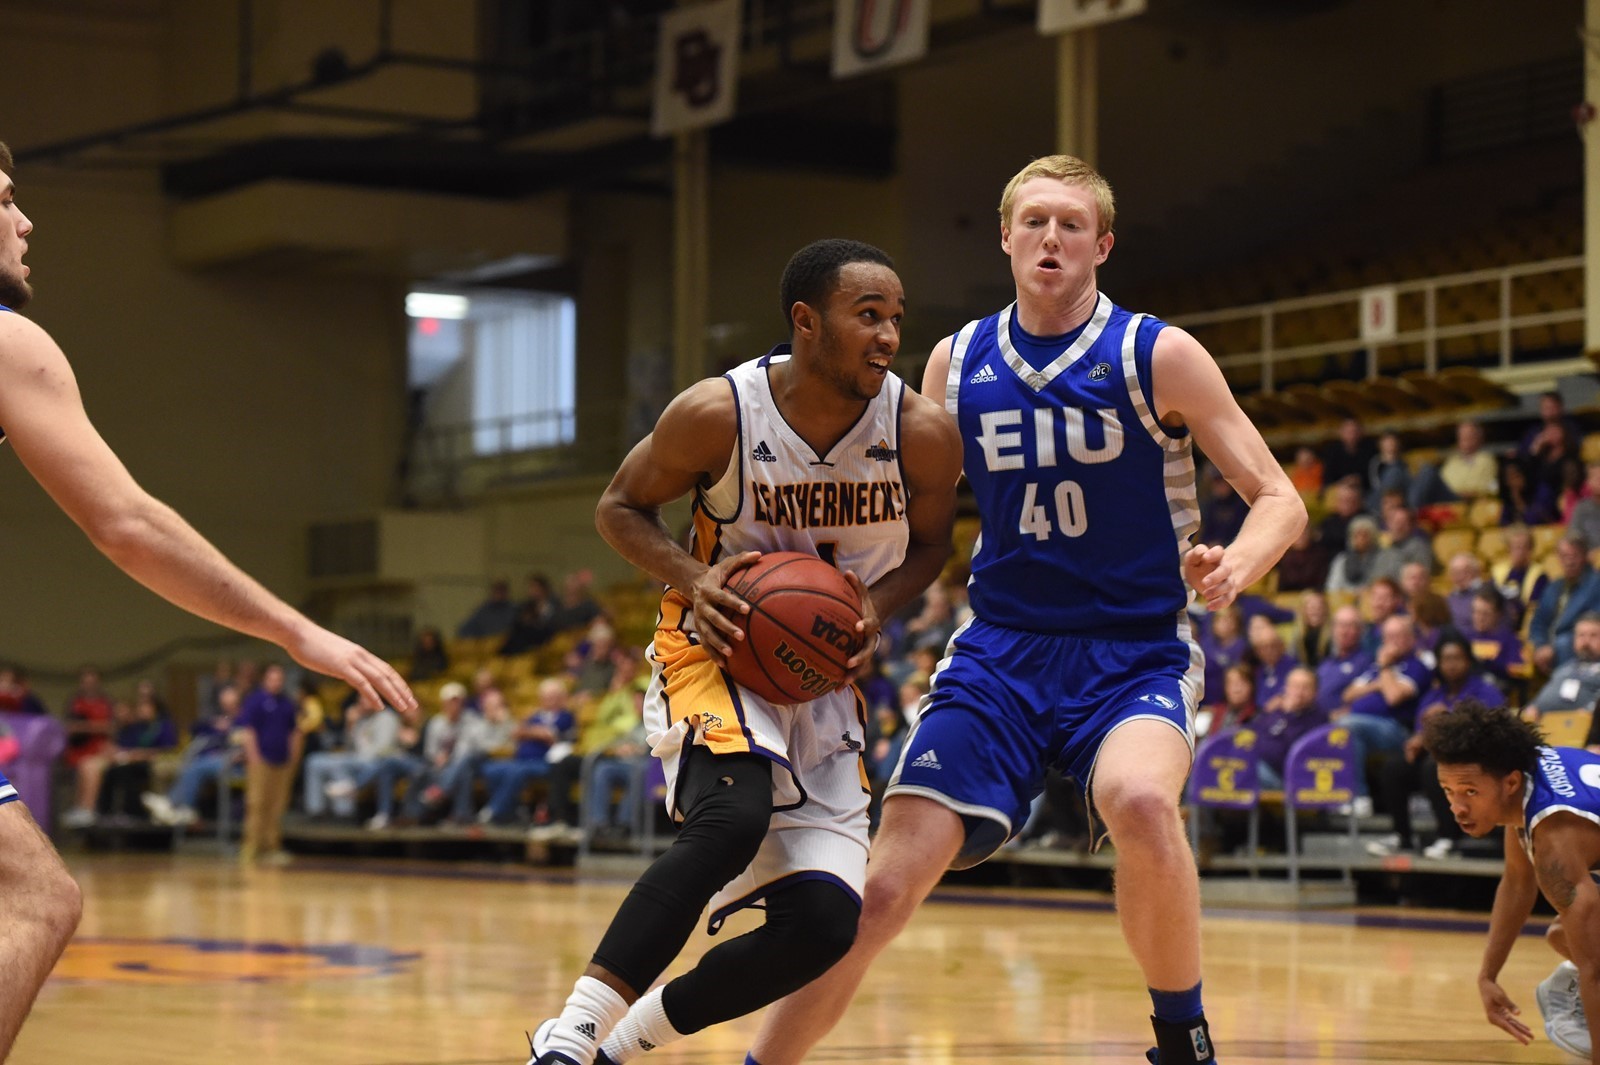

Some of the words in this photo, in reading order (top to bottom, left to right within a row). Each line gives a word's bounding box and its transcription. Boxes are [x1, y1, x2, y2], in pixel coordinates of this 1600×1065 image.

[970, 374, 998, 384] adidas
[975, 406, 1125, 472] EIU
[752, 453, 777, 463] addas
[1019, 480, 1088, 541] 40
[911, 760, 942, 770] adidas
